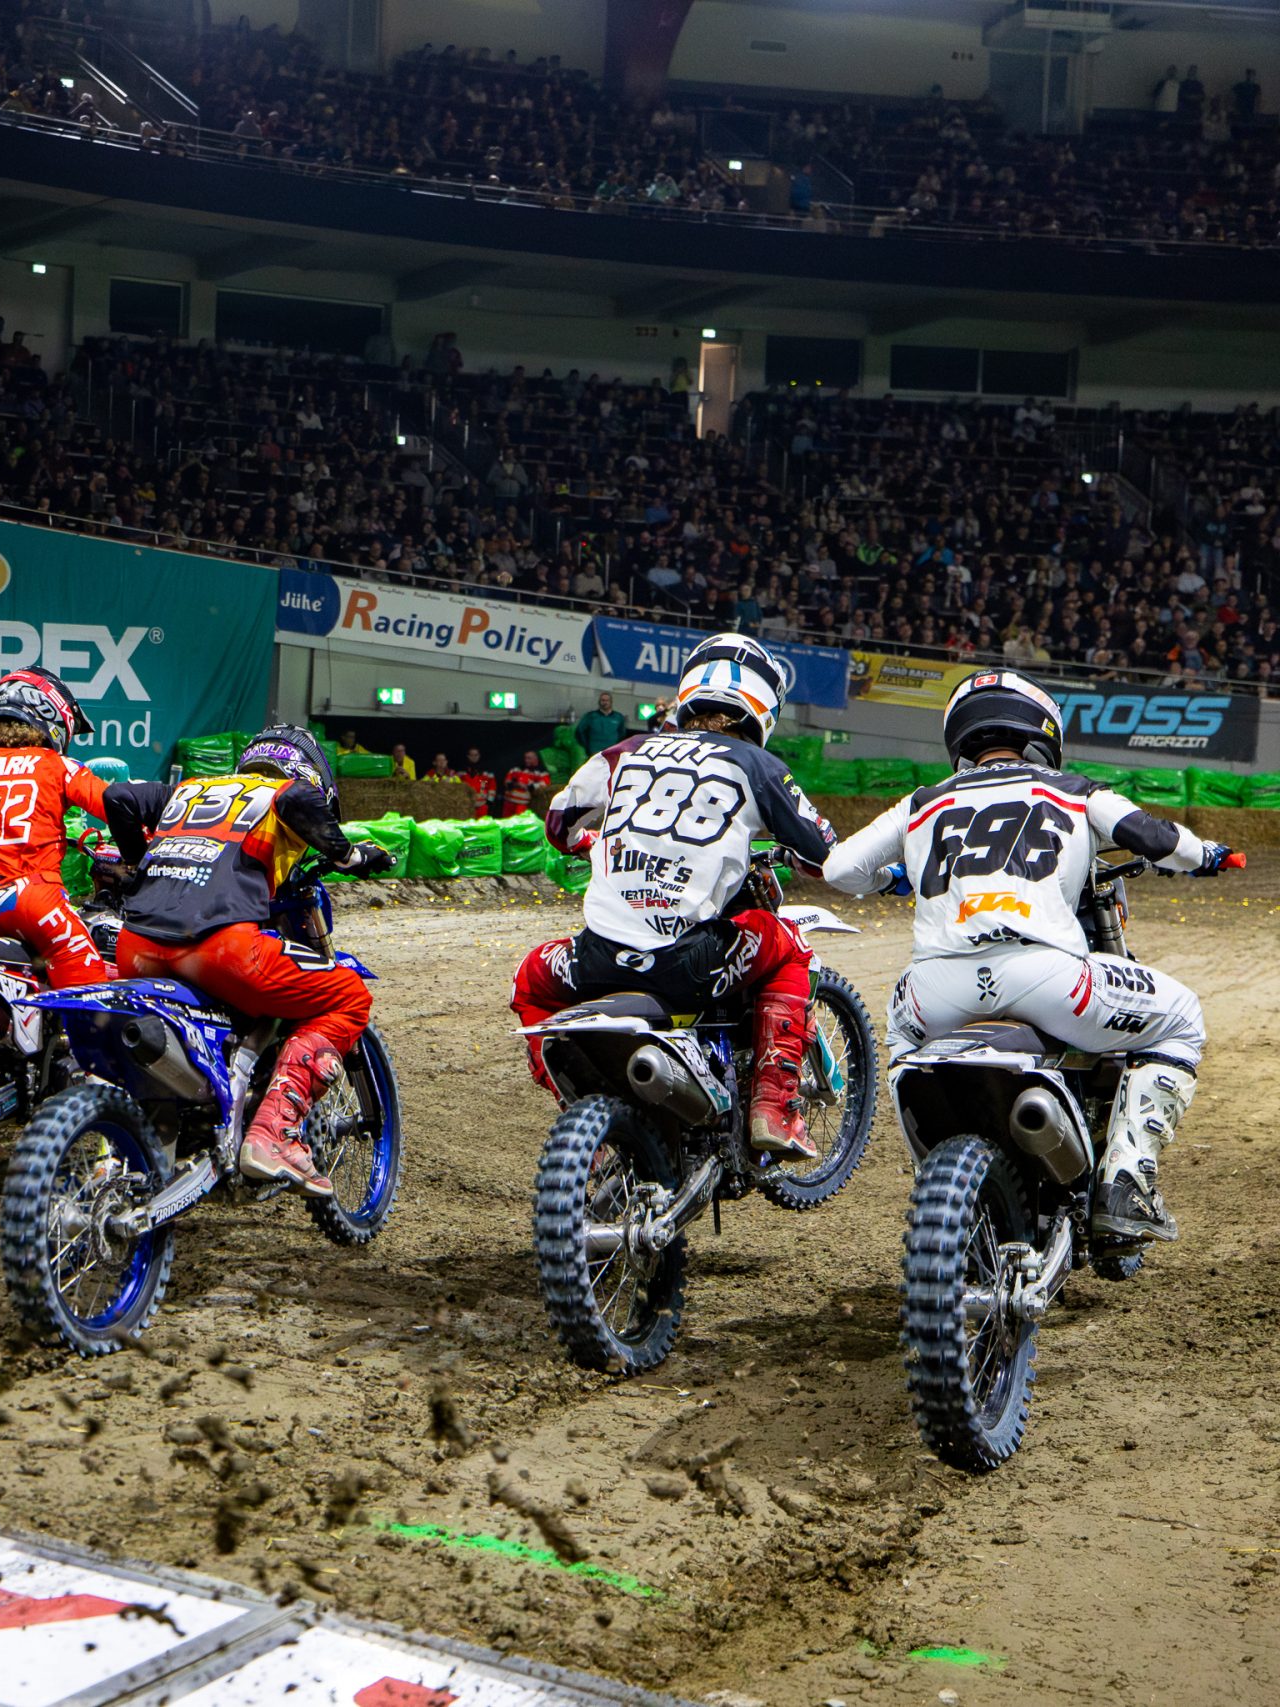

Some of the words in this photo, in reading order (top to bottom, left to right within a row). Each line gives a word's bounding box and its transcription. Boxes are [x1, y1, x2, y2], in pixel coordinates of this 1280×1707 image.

[635, 642, 689, 676] Alli
[1050, 693, 1232, 737] ROSS
[630, 736, 732, 766] RAY
[1128, 735, 1208, 749] MAGAZIN
[159, 782, 278, 832] 831
[602, 764, 747, 847] 388
[154, 843, 217, 860] MEYER
[919, 799, 1076, 900] 696
[954, 891, 1032, 924] KTM
[82, 990, 115, 1002] MEYER
[1103, 1010, 1150, 1035] KTM
